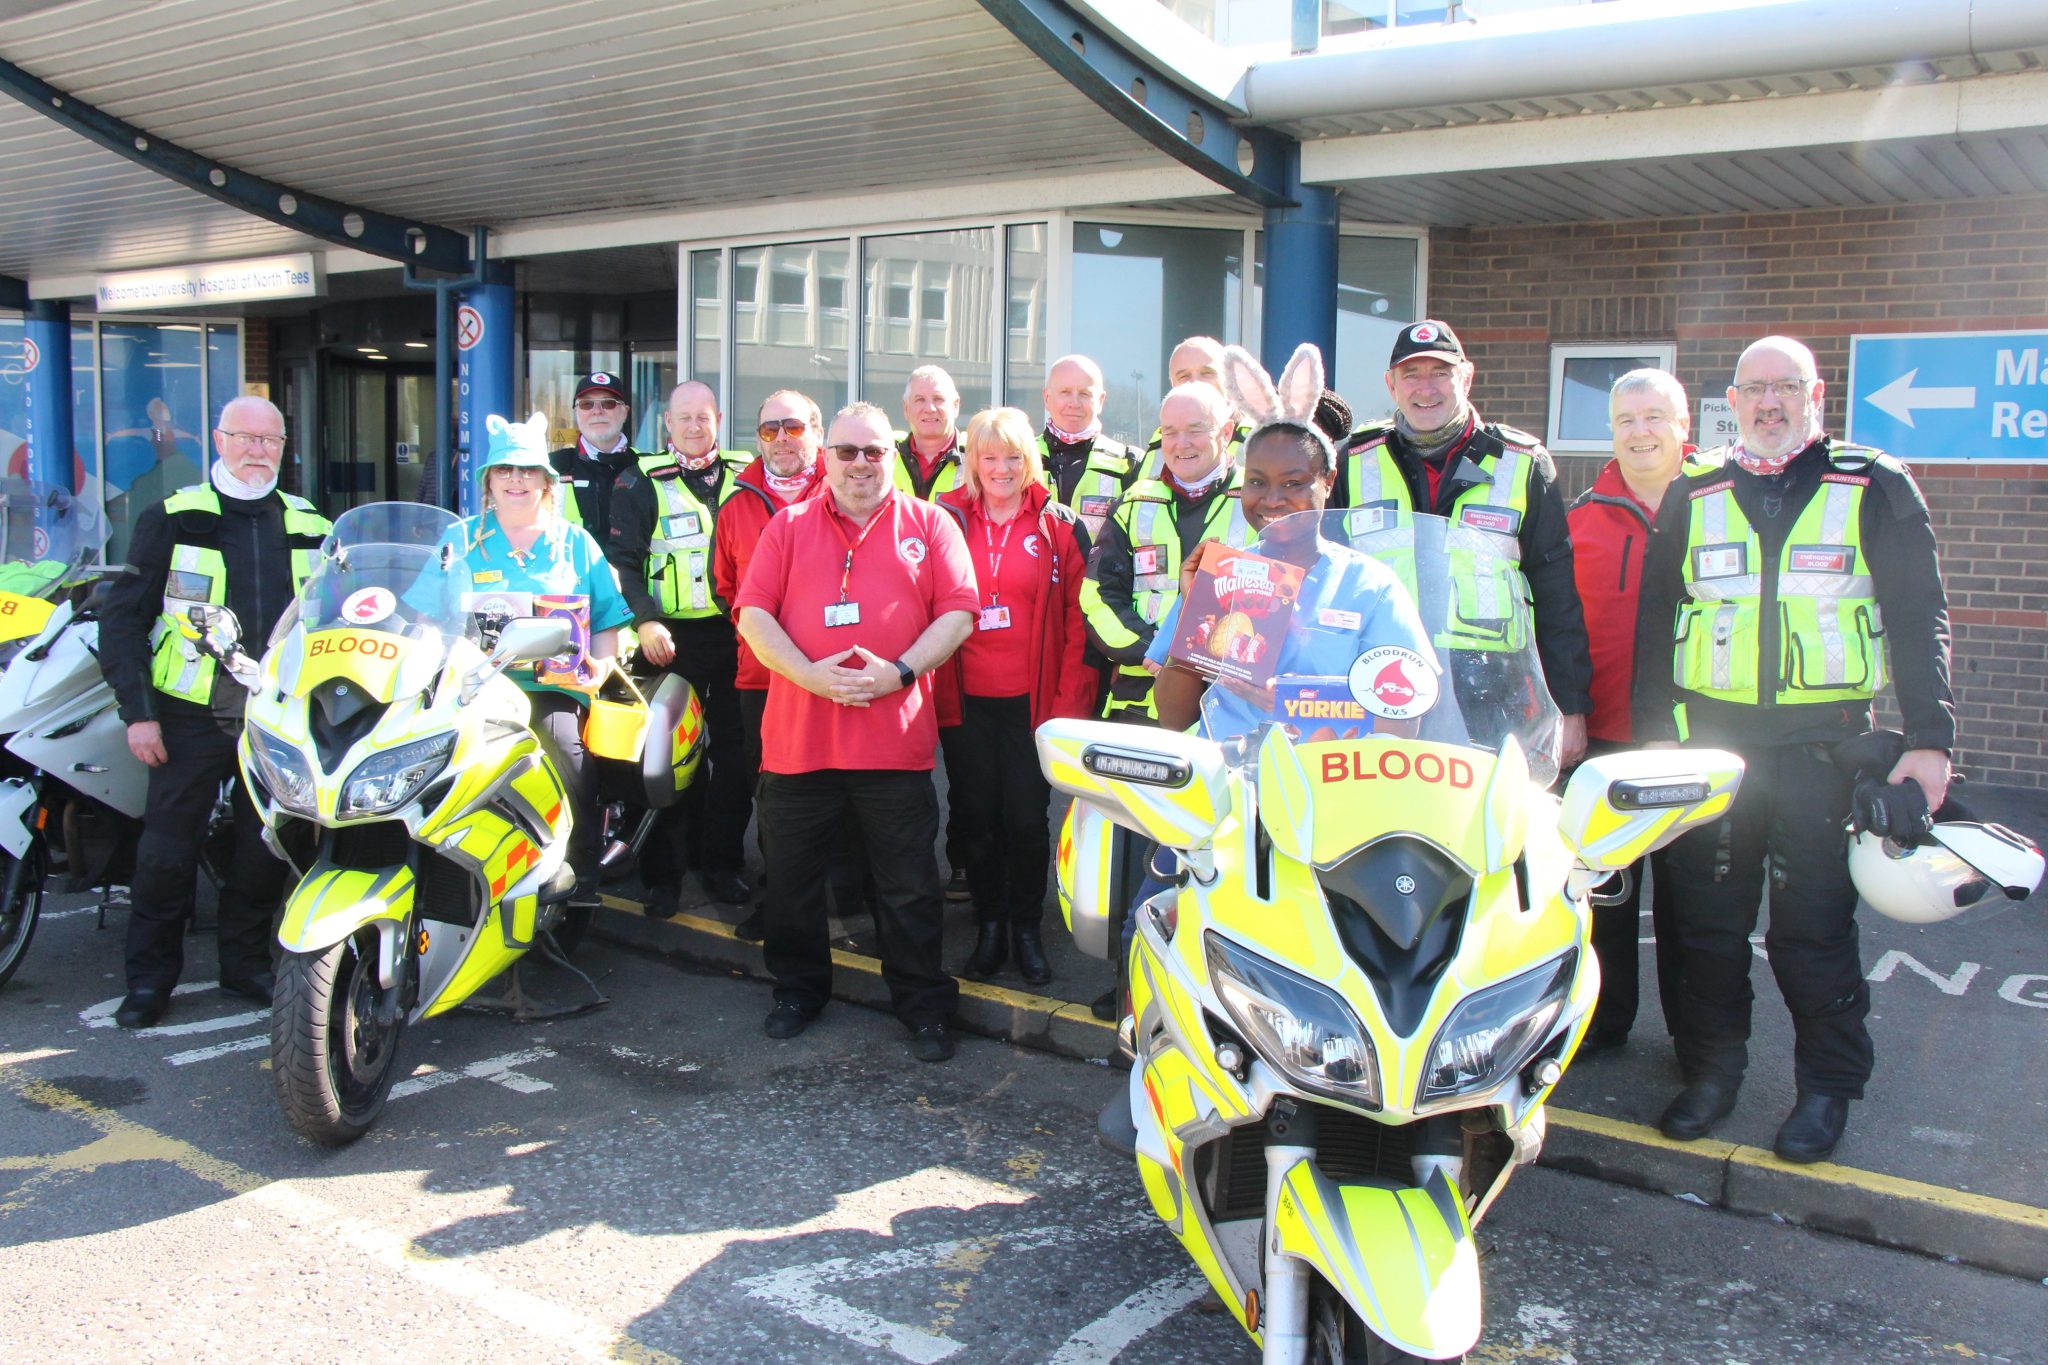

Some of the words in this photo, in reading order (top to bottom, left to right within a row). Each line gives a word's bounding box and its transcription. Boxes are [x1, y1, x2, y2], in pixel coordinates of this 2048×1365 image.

[99, 284, 139, 301] Welcome
[141, 284, 150, 297] to
[152, 278, 198, 298] University
[199, 273, 239, 294] Hospital
[241, 273, 251, 288] of
[254, 270, 282, 287] North
[285, 269, 310, 286] Tees
[461, 363, 470, 396] NO
[461, 411, 470, 518] SMOKIN
[1690, 481, 1732, 499] VOLUNTEER
[1823, 473, 1867, 486] VOLUNTEER
[1799, 554, 1838, 562] EMERGENCY
[310, 636, 399, 660] BLOOD
[1361, 648, 1425, 668] BLOODRUN
[1284, 700, 1365, 719] YORKIE
[1321, 749, 1474, 790] BLOOD
